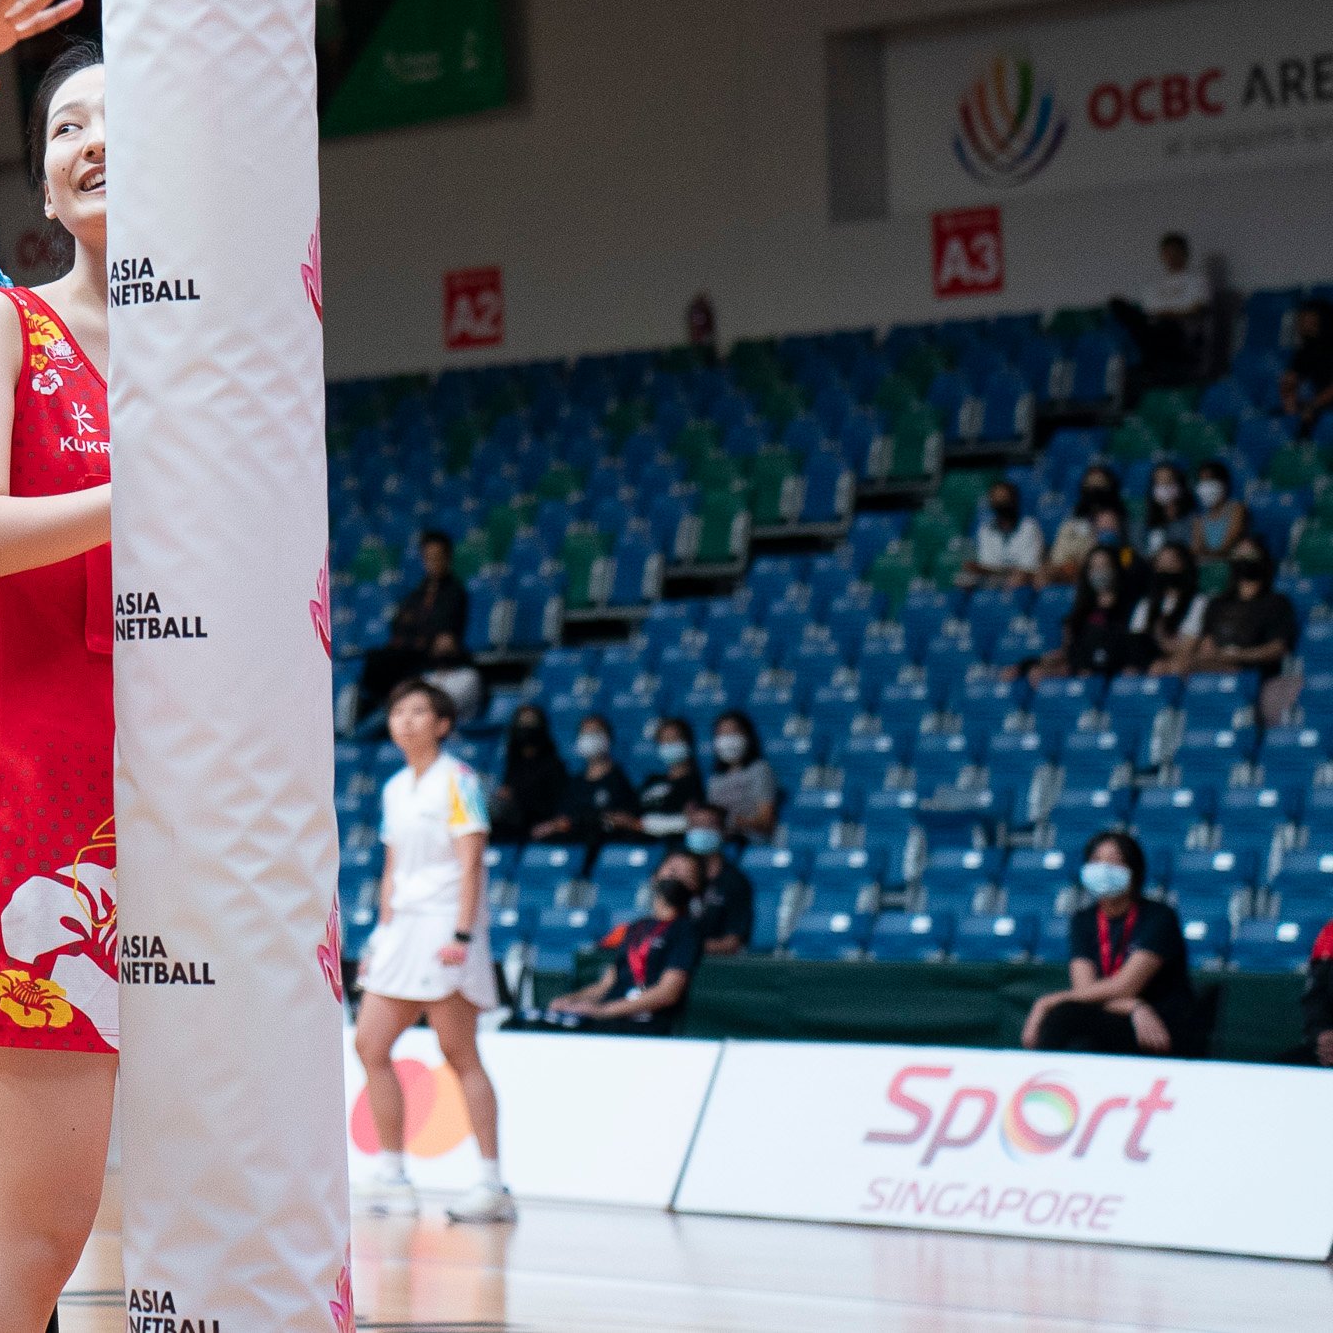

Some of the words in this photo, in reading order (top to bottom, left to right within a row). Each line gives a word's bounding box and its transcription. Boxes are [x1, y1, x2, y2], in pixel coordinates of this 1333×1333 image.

[1087, 67, 1227, 132] OCBC
[109, 257, 155, 284] ASIA
[938, 233, 999, 286] A3
[109, 278, 201, 308] NETBALL
[449, 291, 501, 339] A2
[114, 591, 162, 617] ASIA
[115, 615, 208, 642] NETBALL
[121, 934, 169, 959] ASIA
[120, 961, 216, 985] NETBALL
[862, 1063, 1177, 1168] Sport
[859, 1176, 1125, 1231] SINGAPORE
[128, 1289, 177, 1314] ASIA
